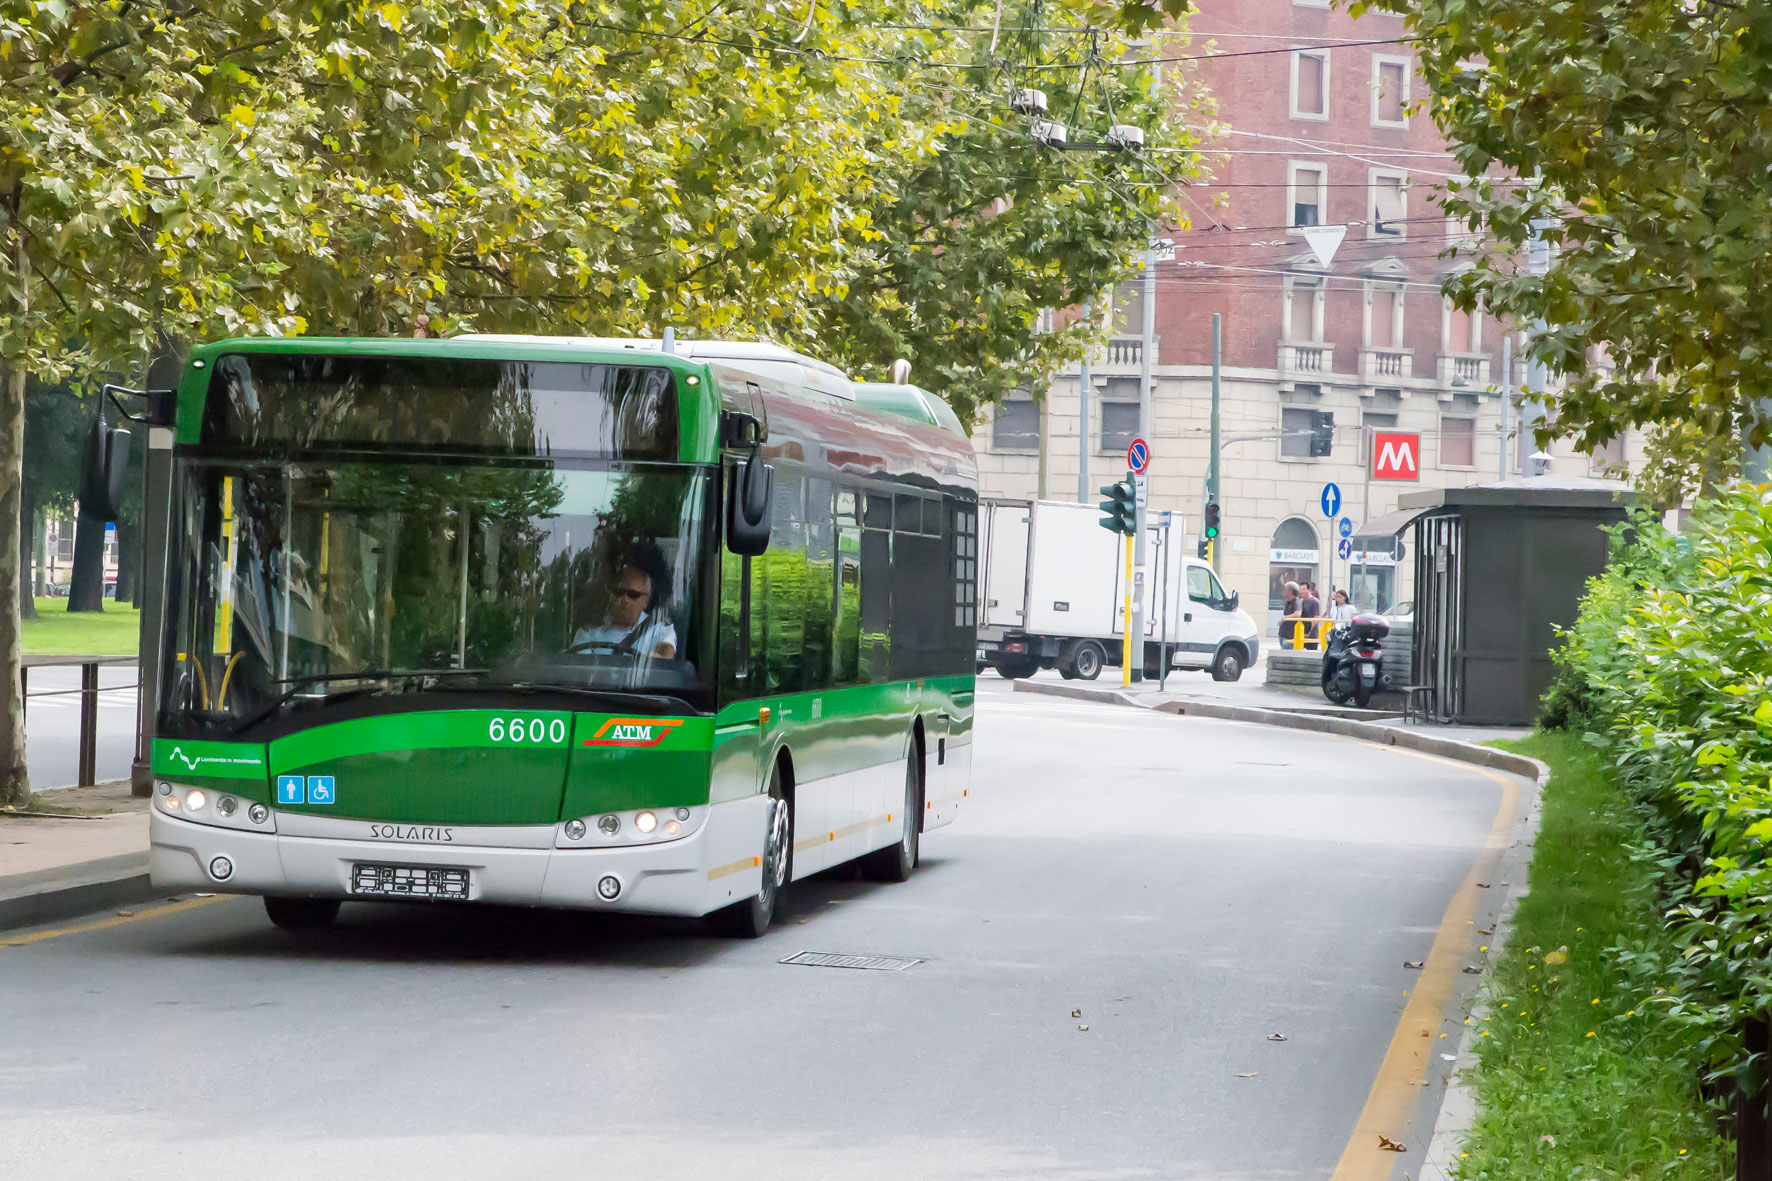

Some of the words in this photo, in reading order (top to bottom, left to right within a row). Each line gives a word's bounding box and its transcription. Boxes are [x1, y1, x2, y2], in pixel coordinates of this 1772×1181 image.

[1377, 441, 1416, 472] M
[1283, 551, 1314, 560] BARCLAYS
[1365, 553, 1391, 562] ARCLAY
[489, 717, 566, 743] 6600
[611, 725, 652, 740] ATM
[370, 824, 453, 841] SOLARIS
